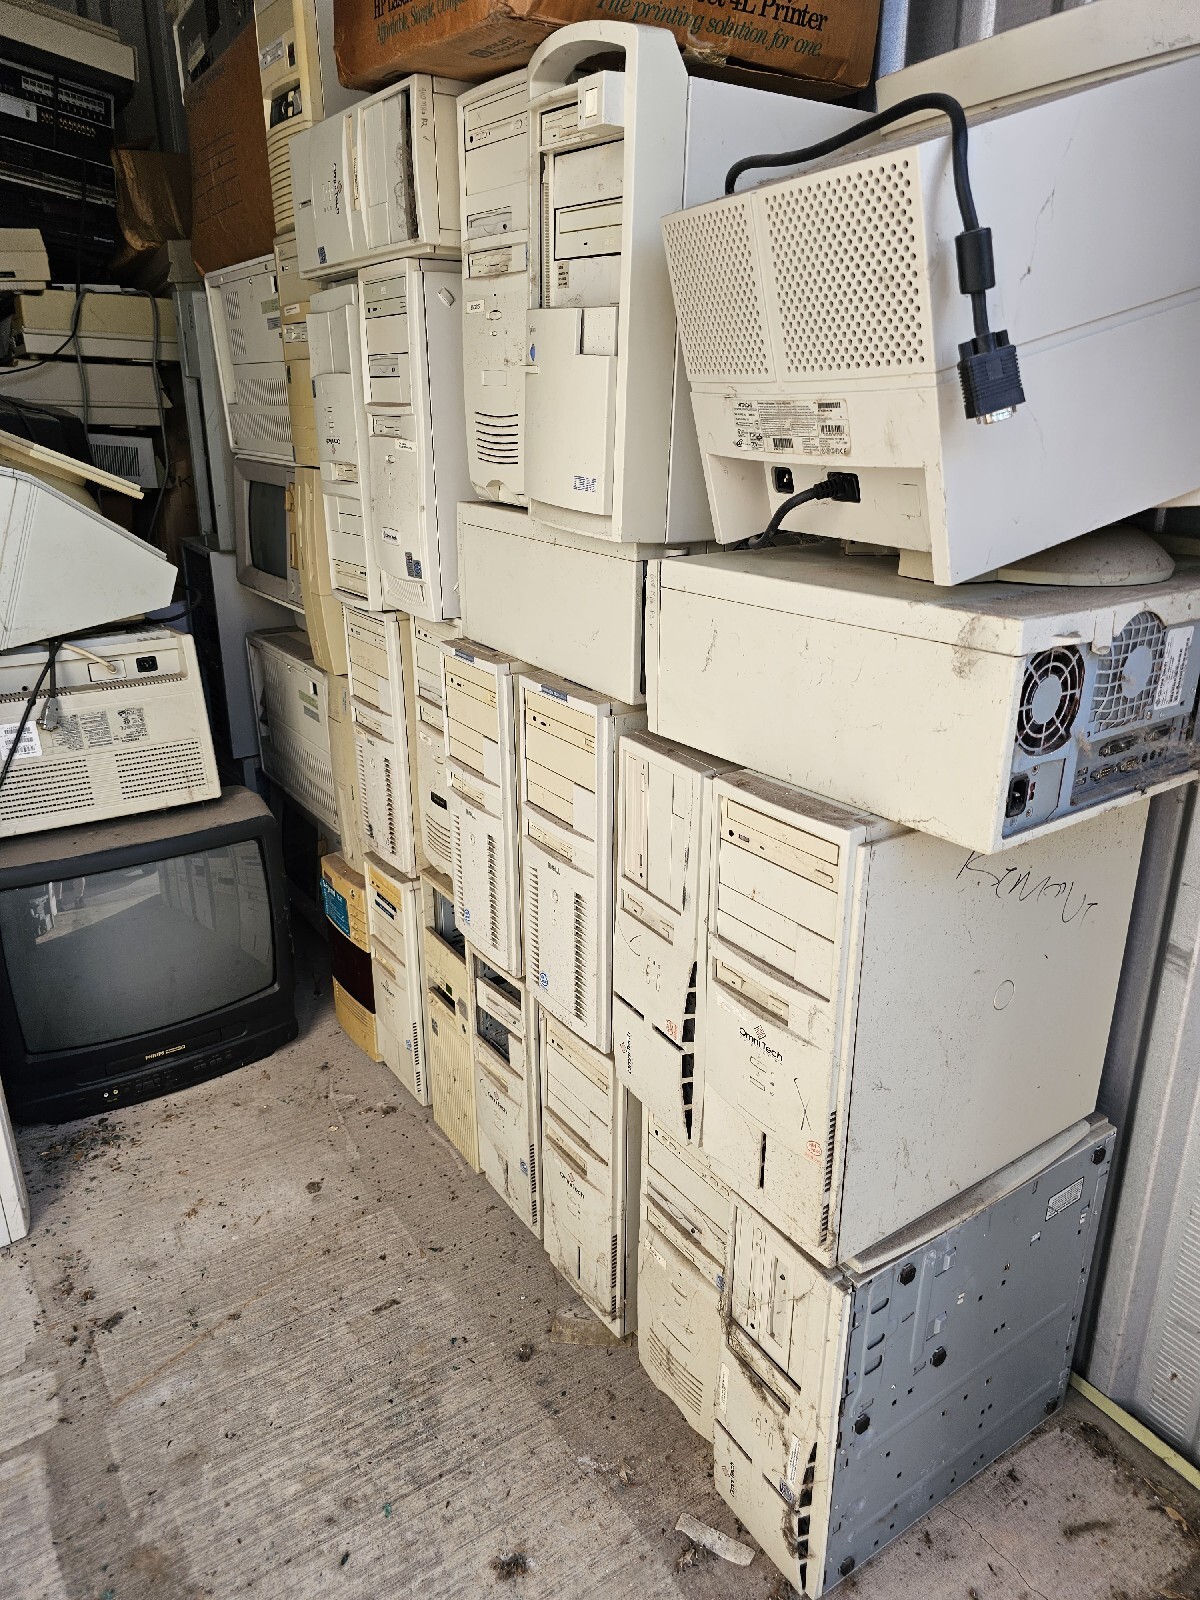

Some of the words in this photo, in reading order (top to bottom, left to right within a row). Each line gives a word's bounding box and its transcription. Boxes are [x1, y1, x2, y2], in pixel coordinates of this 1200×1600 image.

[630, 1, 705, 35] printing
[706, 15, 768, 46] solution
[766, 28, 794, 51] for
[758, 0, 829, 31] Printer
